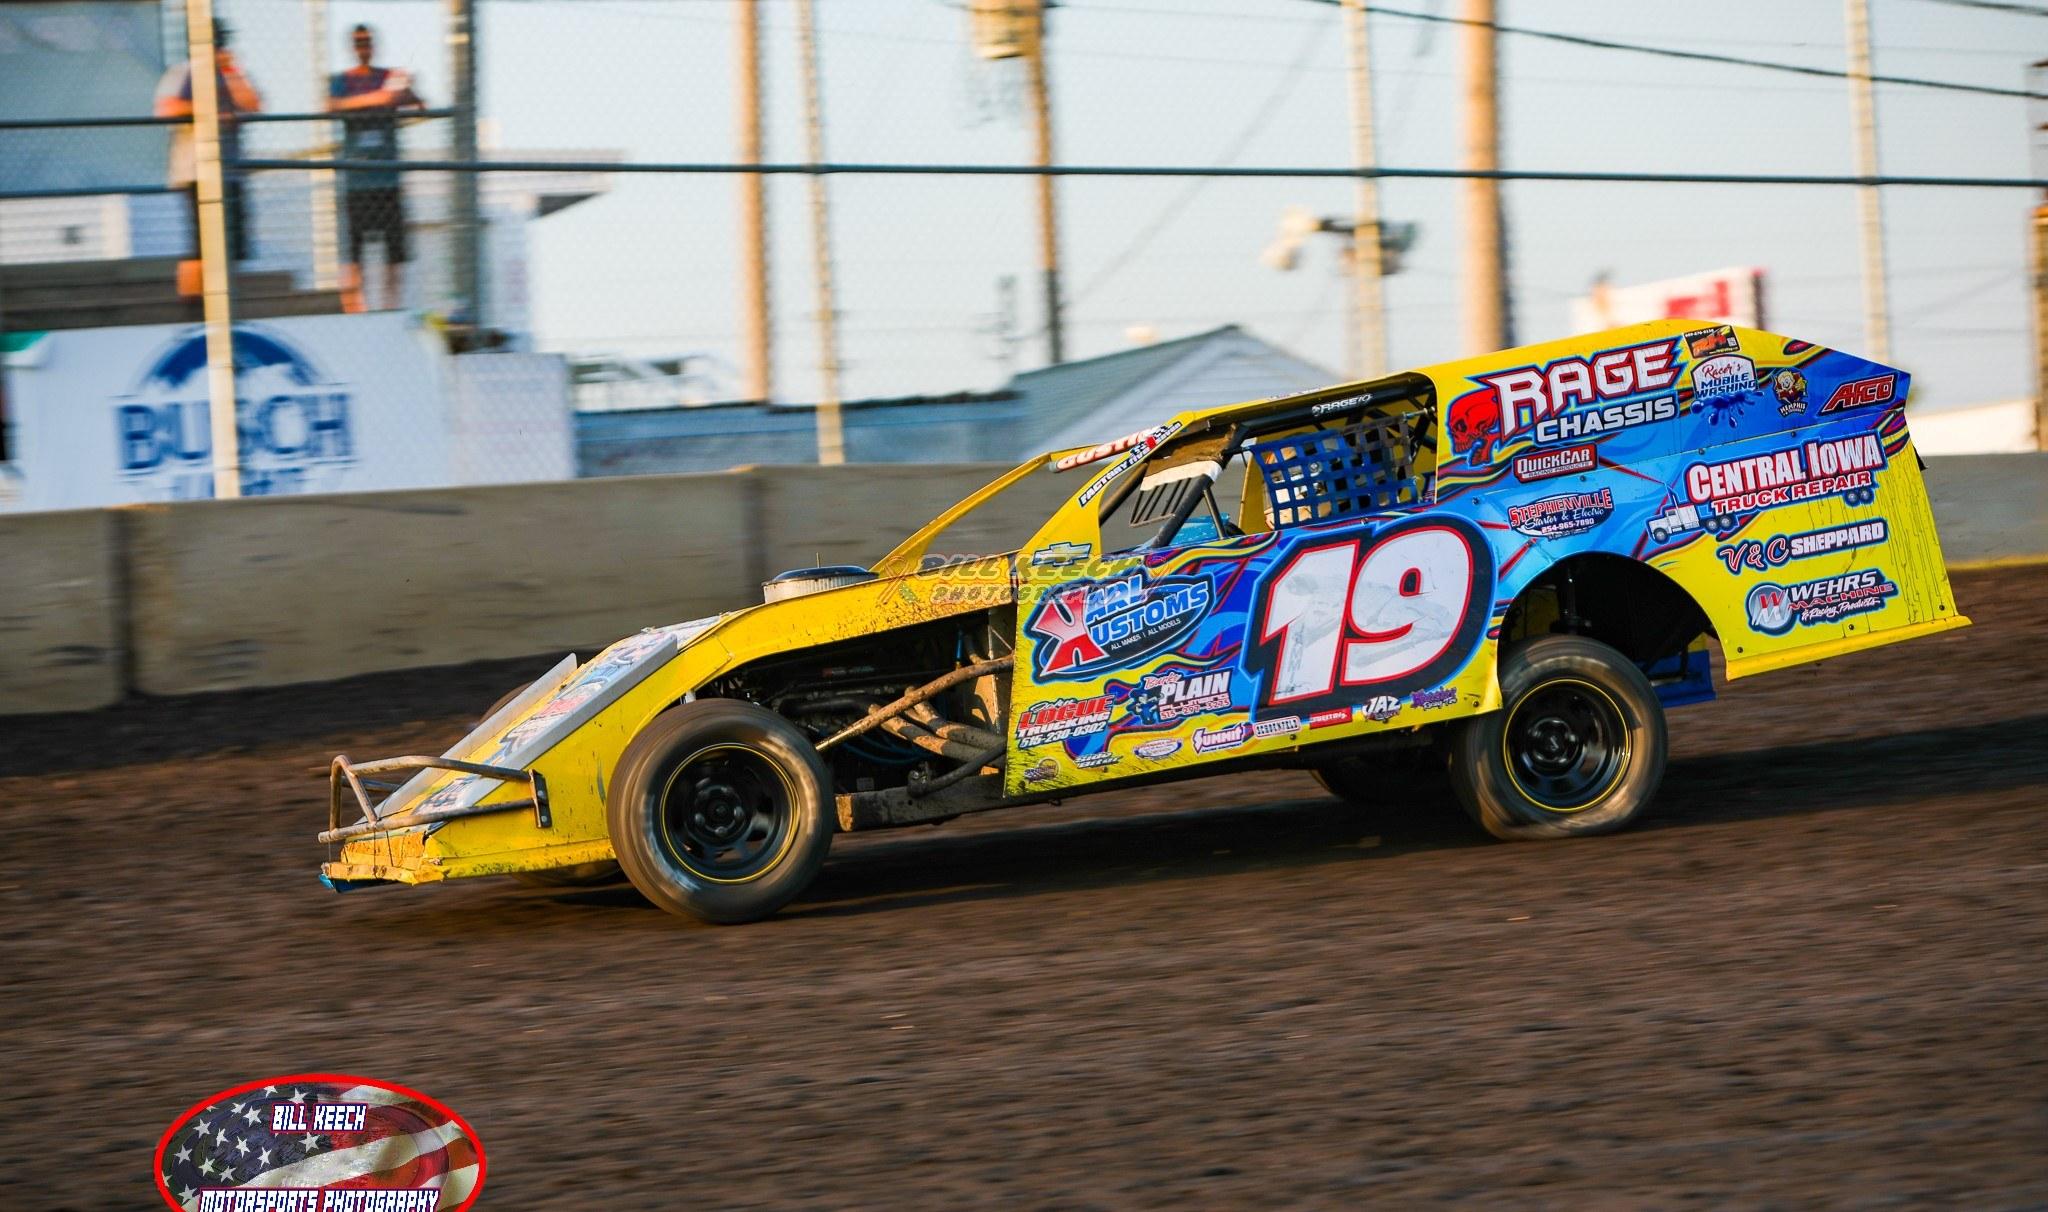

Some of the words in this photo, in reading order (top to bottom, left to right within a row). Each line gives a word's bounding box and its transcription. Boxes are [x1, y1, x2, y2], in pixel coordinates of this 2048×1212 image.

[1483, 341, 1676, 439] RAGE
[1695, 380, 1757, 399] WASHING
[1700, 372, 1750, 389] MOBILE
[1821, 375, 1895, 413] AFCO
[1537, 396, 1676, 443] CHASSIS
[1689, 449, 1806, 501] CENTRAL
[1806, 434, 1884, 478] IOWA
[1508, 488, 1613, 527] STEPHENVILLE
[1712, 487, 1790, 516] TRUCK
[1791, 471, 1872, 501] REPAIR
[1562, 510, 1569, 521] &
[1720, 543, 1748, 571] V
[1747, 544, 1765, 568] &
[1768, 538, 1790, 562] C
[1791, 522, 1884, 557] SHEPPARD
[1788, 583, 1895, 611] MACHINE
[1791, 571, 1877, 602] WEHRS
[1260, 526, 1475, 706] 19
[1839, 596, 1881, 613] Products
[1110, 642, 1121, 651] ALL
[1121, 634, 1142, 647] MAKES
[1147, 627, 1158, 637] ALL
[1158, 618, 1181, 633] MODELS
[1158, 671, 1231, 705] PLAIN
[1018, 695, 1115, 730] LOGUE
[1362, 695, 1400, 715] JAZ
[1017, 711, 1111, 738] TRUCKING
[1193, 723, 1245, 755] SUMMIT
